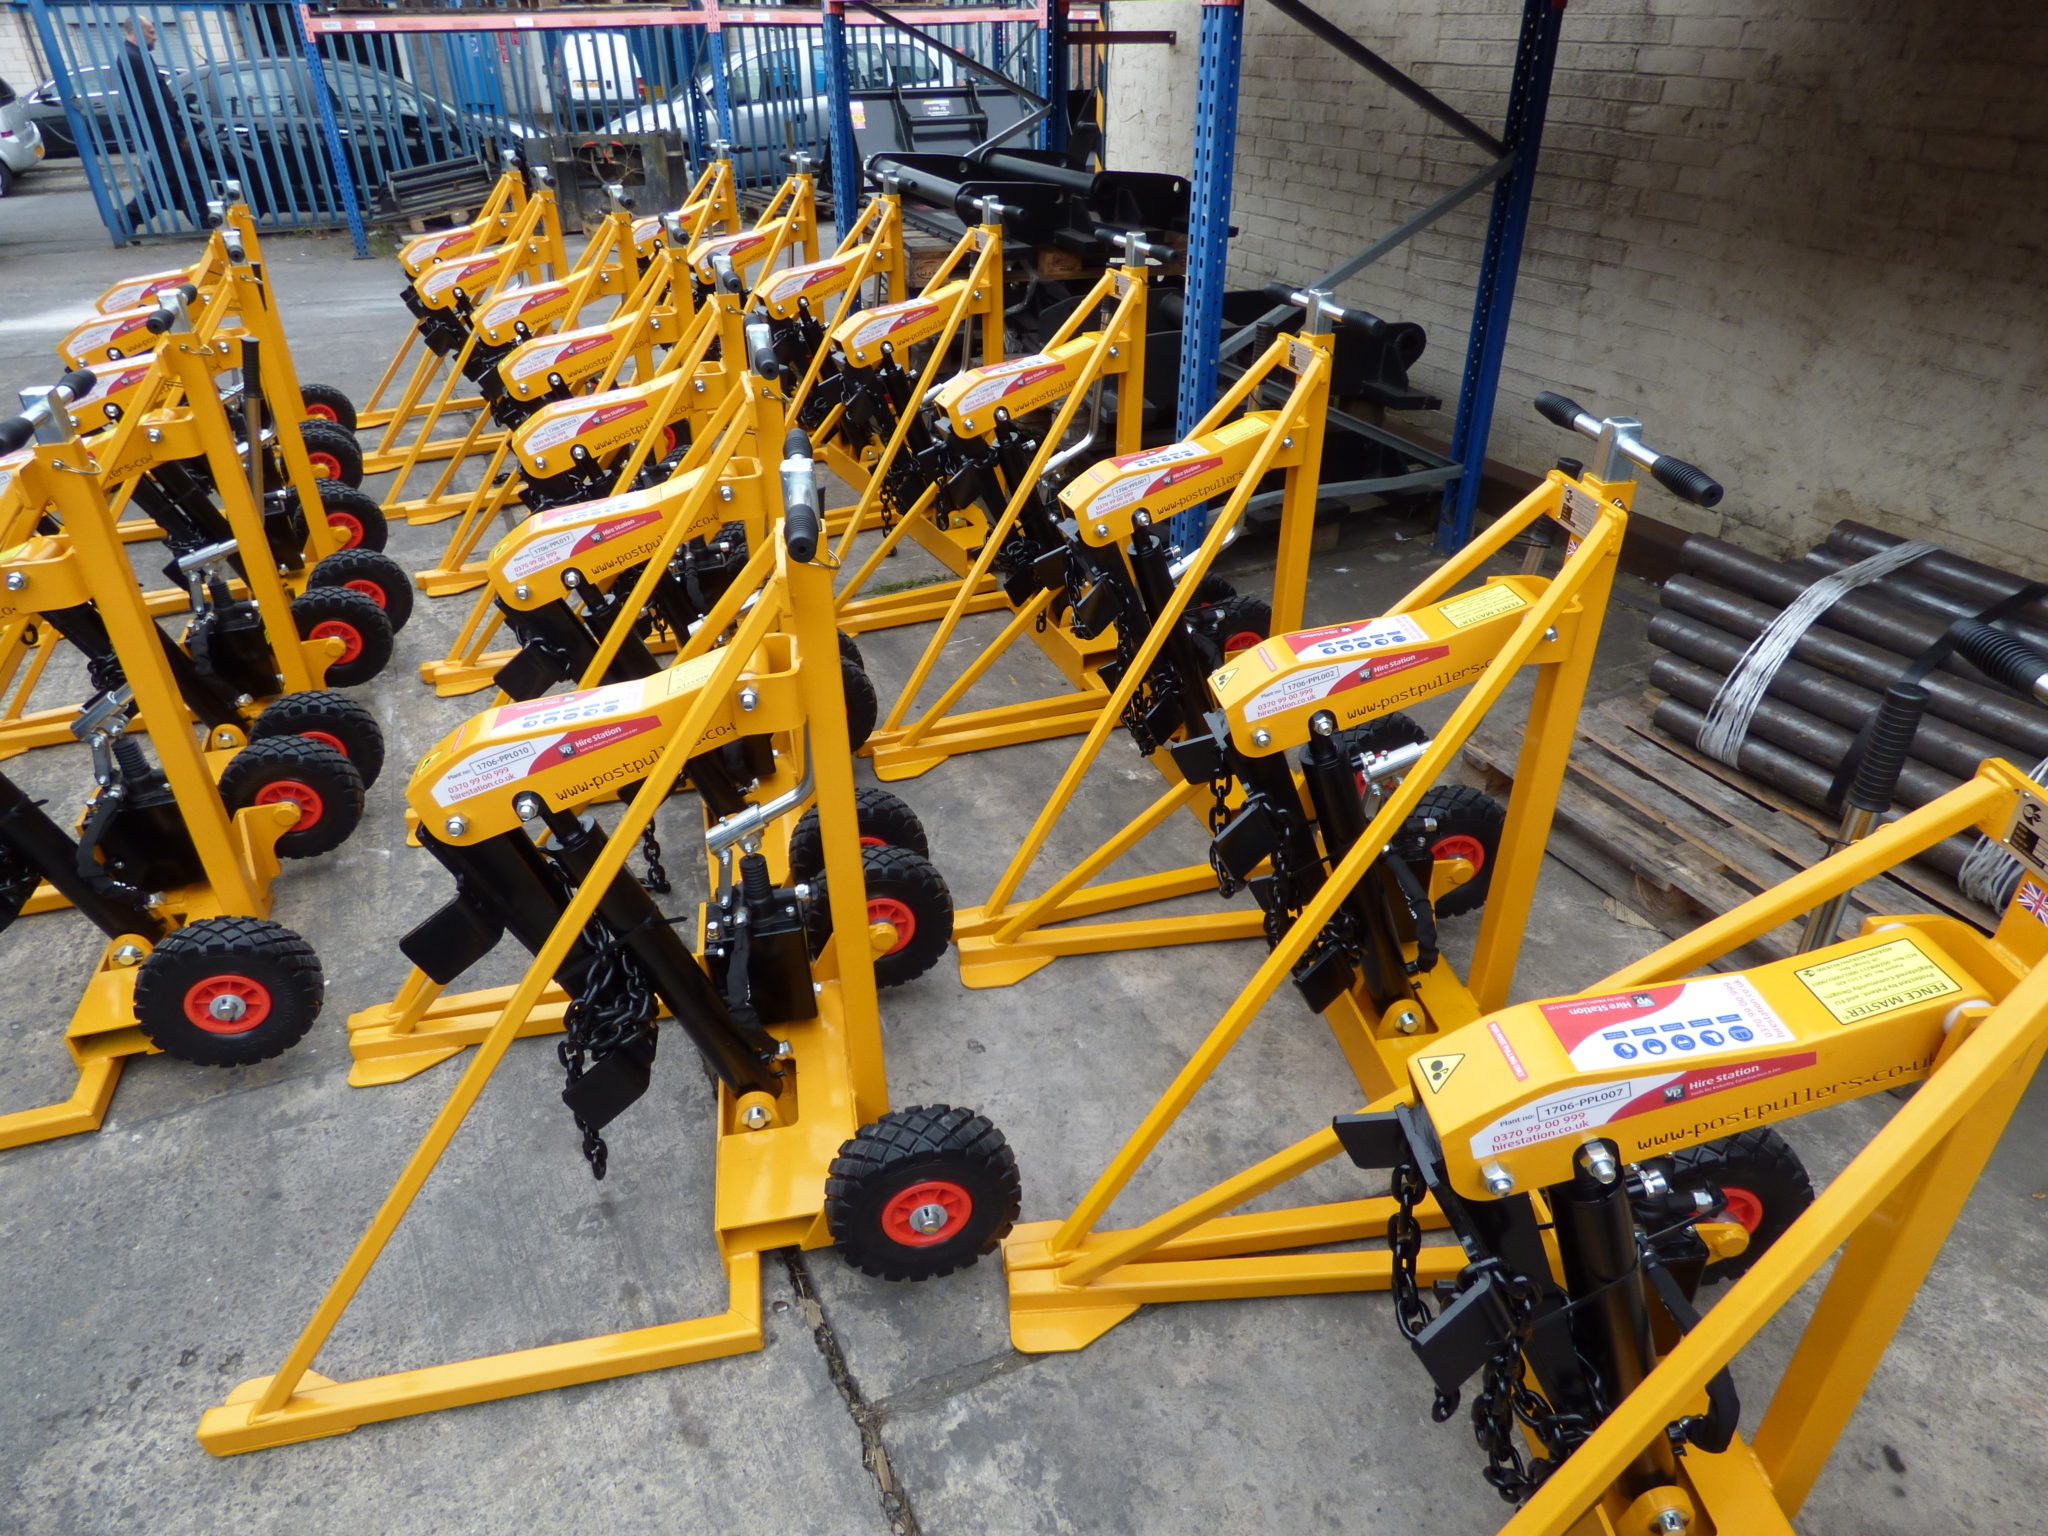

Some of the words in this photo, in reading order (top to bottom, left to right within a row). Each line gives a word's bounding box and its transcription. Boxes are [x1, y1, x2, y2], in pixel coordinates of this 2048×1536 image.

[1185, 464, 1200, 475] Station
[602, 528, 615, 536] Hire
[614, 520, 635, 531] Station
[1374, 662, 1389, 673] Hire
[1390, 655, 1416, 668] Station
[1288, 670, 1335, 691] 1706-PPL002
[1257, 694, 1316, 717] hirestation.co.uk
[1258, 700, 1276, 710] 0370
[1278, 696, 1287, 704] 99
[1288, 692, 1298, 700] 00
[1300, 688, 1313, 696] 999
[575, 737, 592, 748] Hire
[593, 726, 621, 742] Station
[476, 747, 529, 770] 1706-PPL010
[448, 782, 468, 794] 0370
[470, 777, 480, 786] 99
[482, 773, 492, 782] 00
[494, 766, 509, 776] 999
[450, 773, 516, 802] hirestation.co.uk
[1902, 981, 1950, 1001] FENCE
[1569, 1002, 1604, 1015] Station
[1605, 1001, 1632, 1011] Hire
[1689, 1078, 1714, 1091] Hire
[1715, 1065, 1760, 1083] Station
[1544, 1088, 1623, 1116] 1706-PPL007
[1493, 1129, 1523, 1143] 0370
[1526, 1124, 1541, 1134] 99
[1545, 1119, 1560, 1129] 00
[1565, 1112, 1585, 1124] 999
[1500, 1117, 1520, 1127] Plant
[1522, 1114, 1535, 1122] no:
[1492, 1120, 1589, 1152] hirestation.co.uk
